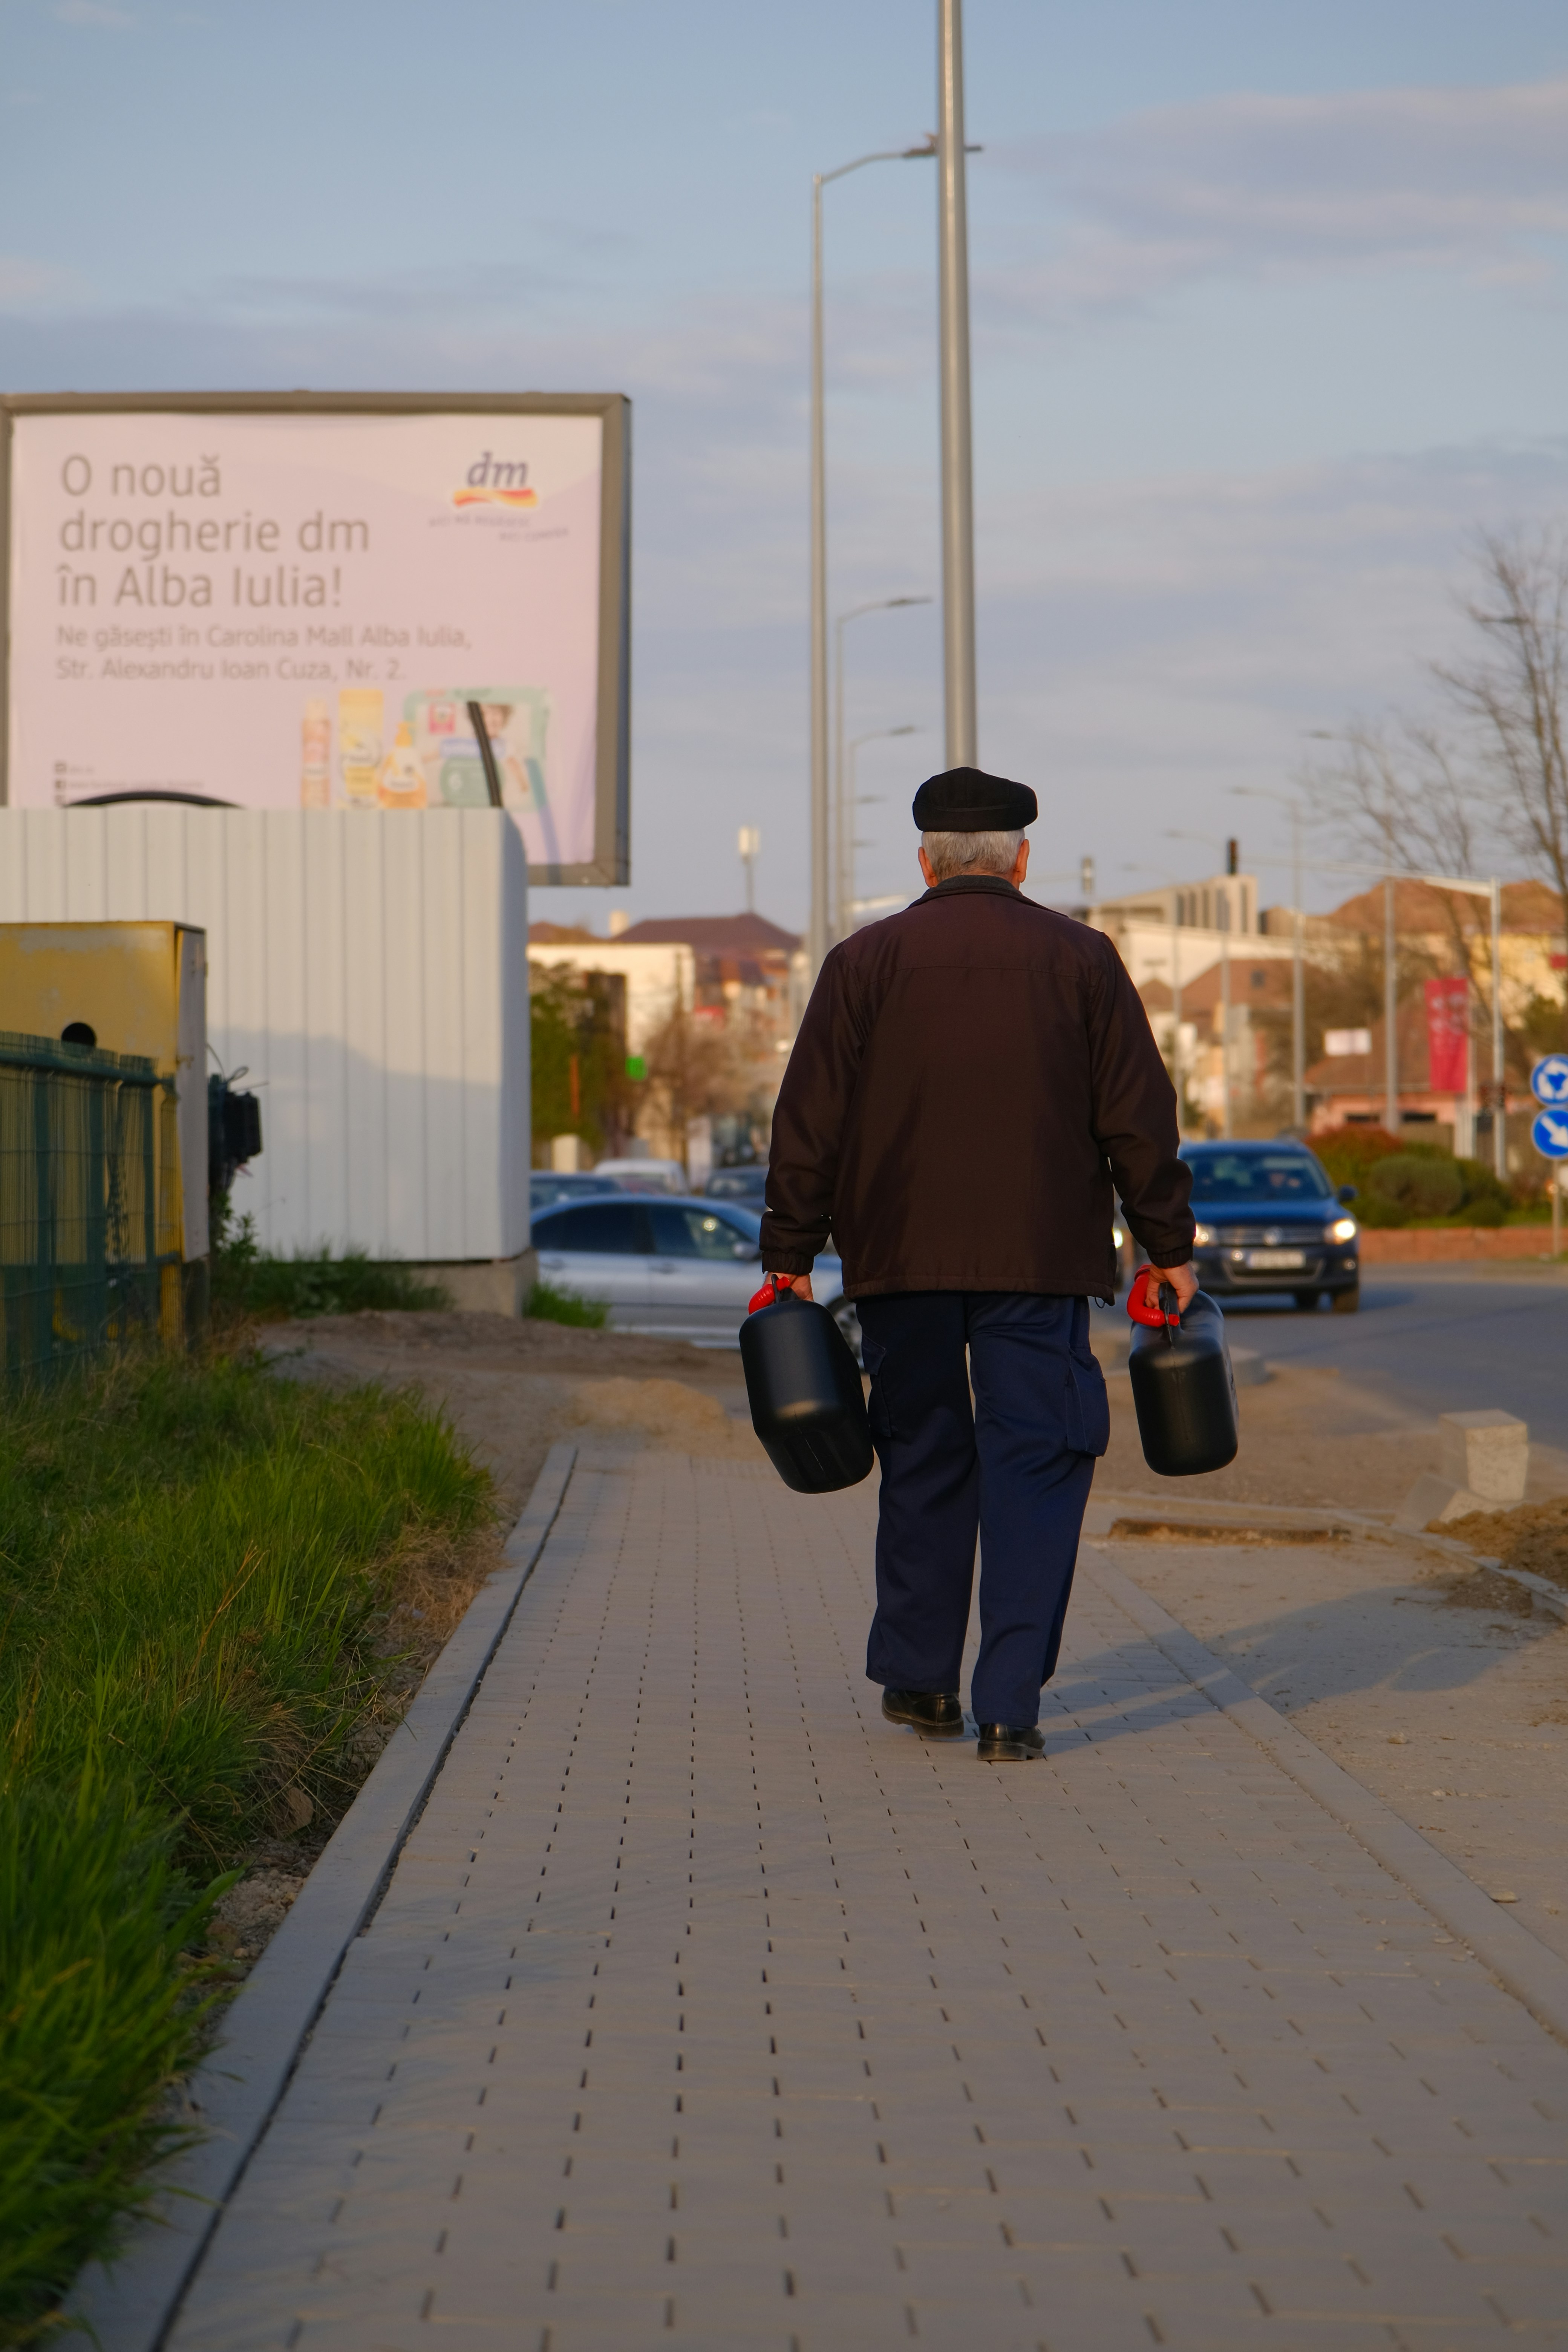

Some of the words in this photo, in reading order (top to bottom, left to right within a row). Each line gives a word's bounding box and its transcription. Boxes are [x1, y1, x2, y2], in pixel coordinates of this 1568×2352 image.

[60, 453, 93, 497] O
[111, 455, 221, 498] nouă
[466, 451, 529, 488] dm
[59, 509, 280, 562] drogherie
[297, 510, 370, 553] dm
[56, 563, 97, 606] în
[114, 565, 213, 608] Alba
[233, 565, 341, 608] Iulia!
[57, 625, 87, 647] Ne
[178, 624, 200, 647] în
[206, 624, 299, 648] Carolina
[306, 625, 353, 647] Mall
[360, 625, 410, 648] Alba
[416, 625, 472, 650] Iulia,
[56, 656, 93, 680] Str.
[101, 657, 214, 680] Alexandru
[220, 658, 271, 680] Ioan
[276, 657, 338, 682] Cuza,
[346, 658, 378, 680] Nr.
